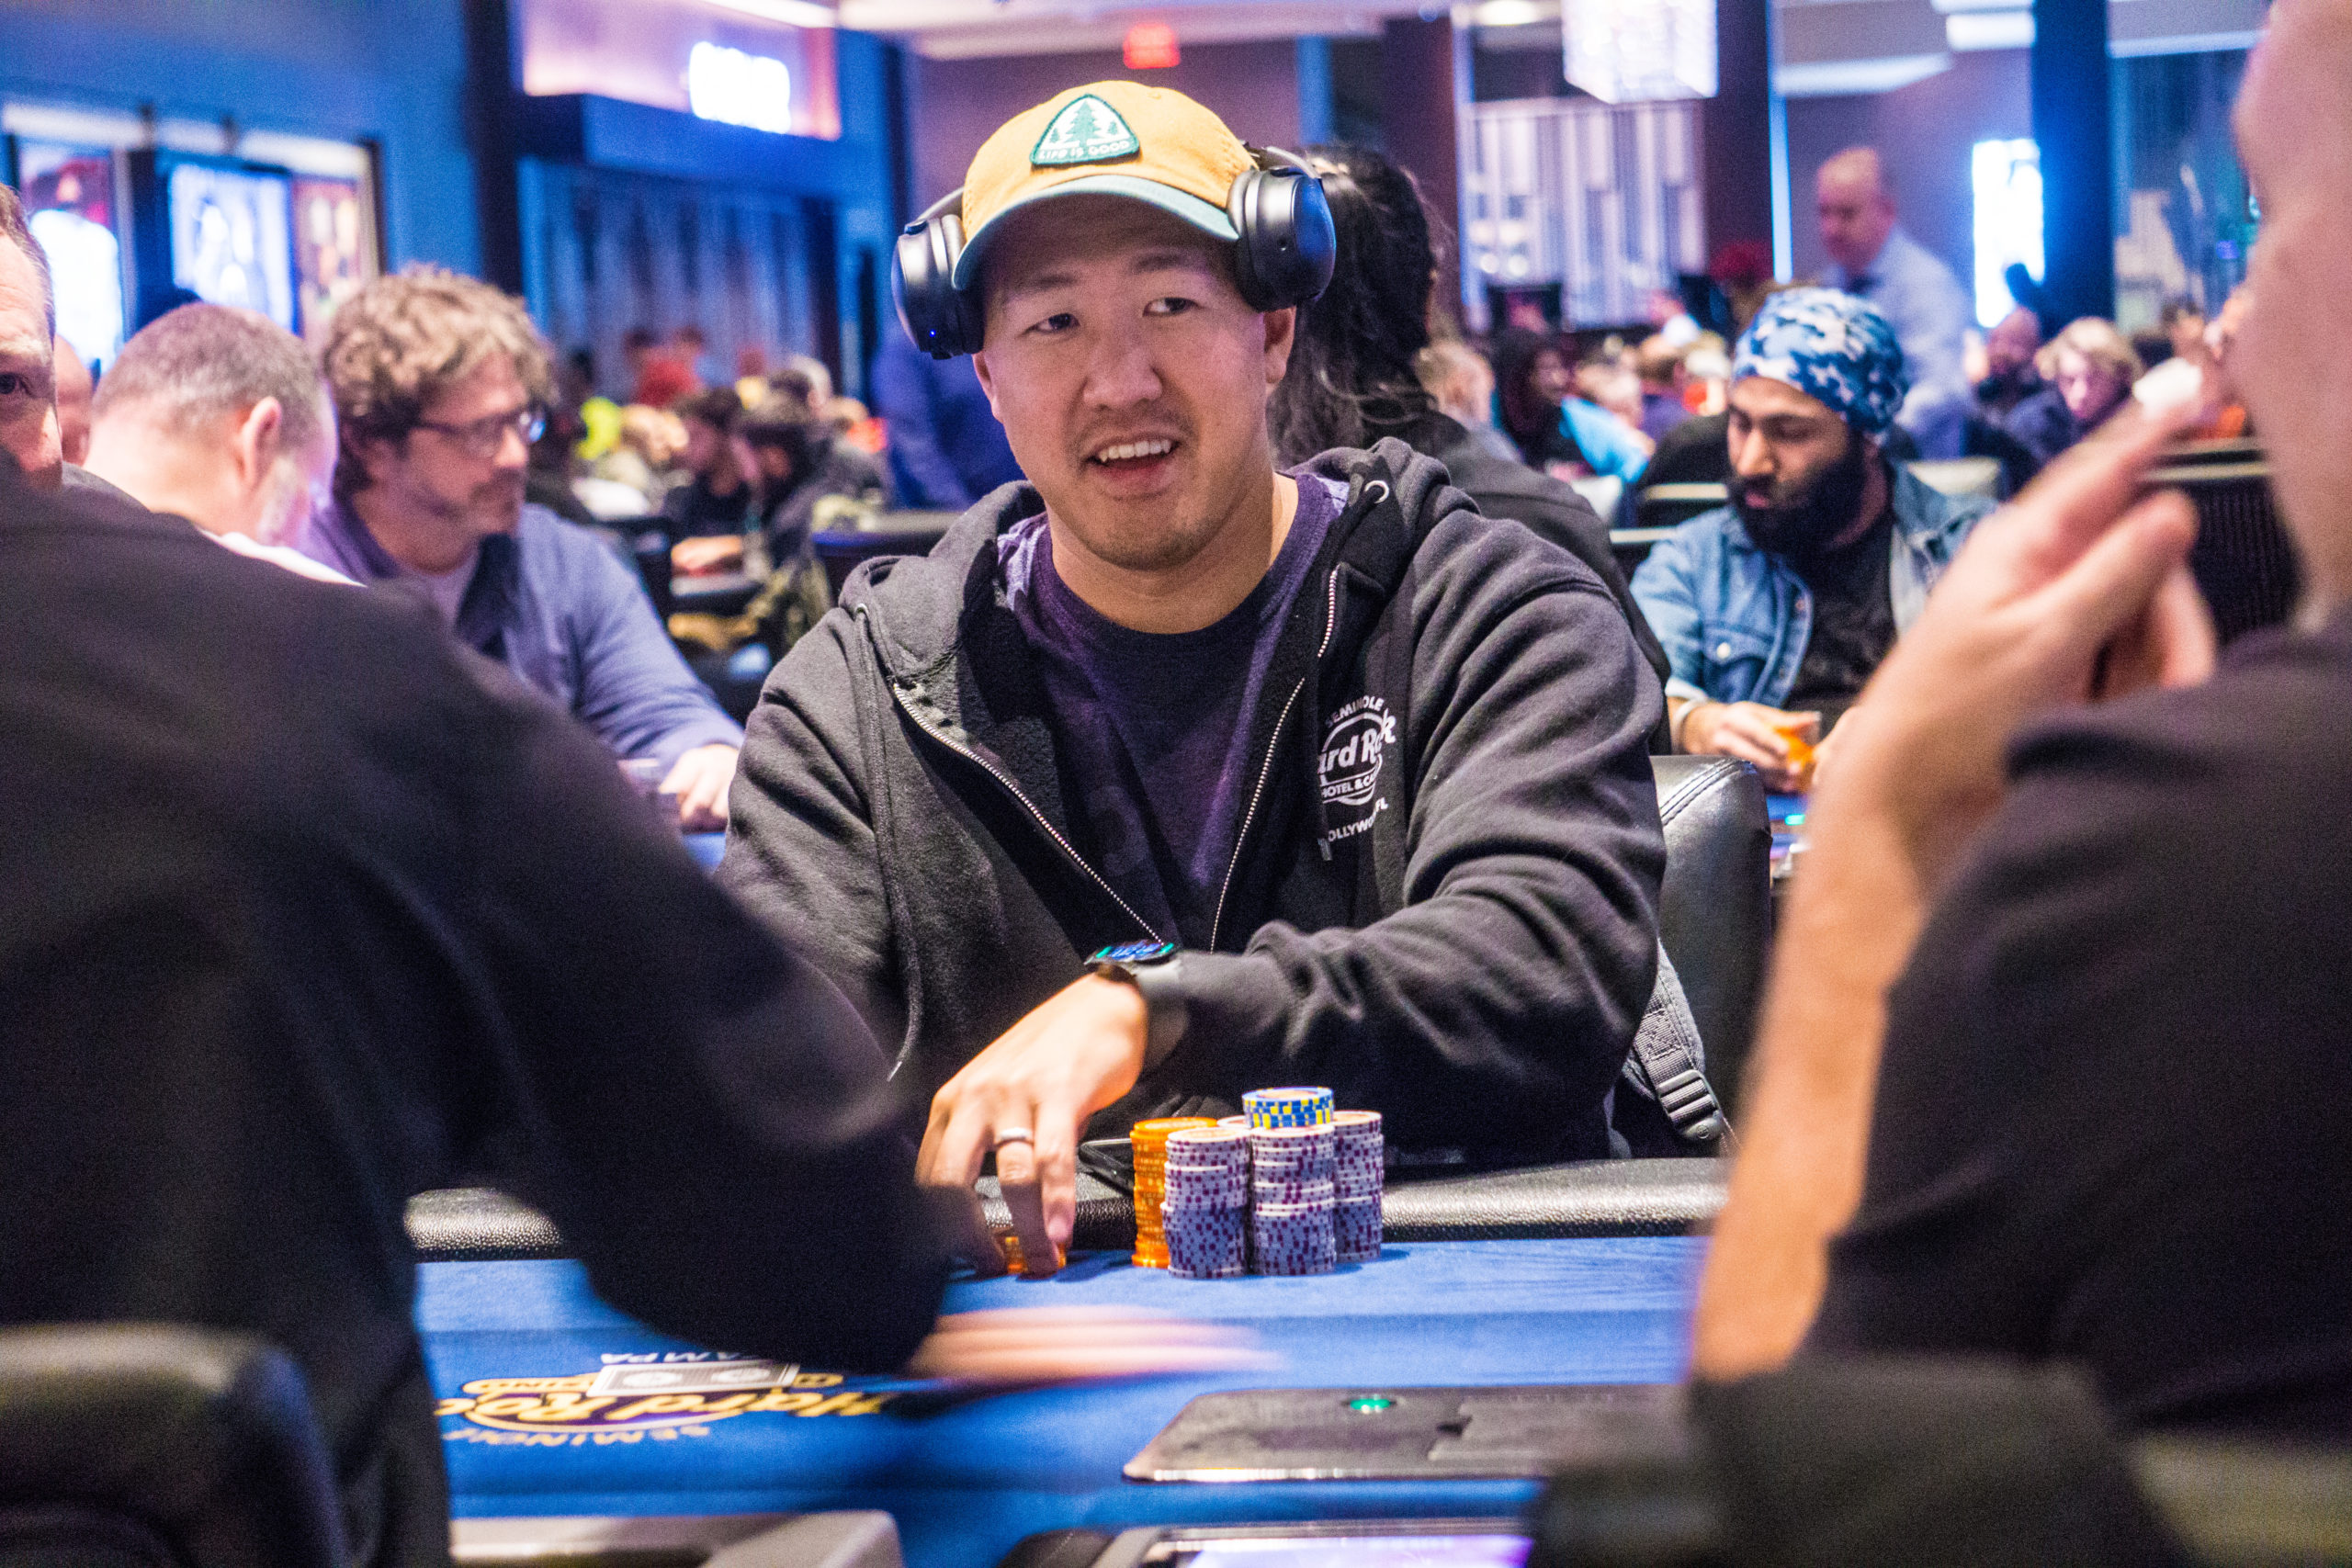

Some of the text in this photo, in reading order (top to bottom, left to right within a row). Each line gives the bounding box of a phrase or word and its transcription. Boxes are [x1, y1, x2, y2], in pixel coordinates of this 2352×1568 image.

[1088, 141, 1130, 156] GOOD
[1325, 694, 1385, 728] SEMINOLE
[1317, 734, 1360, 775] ard
[601, 1351, 742, 1366] AMPA
[434, 1392, 618, 1422] Roc
